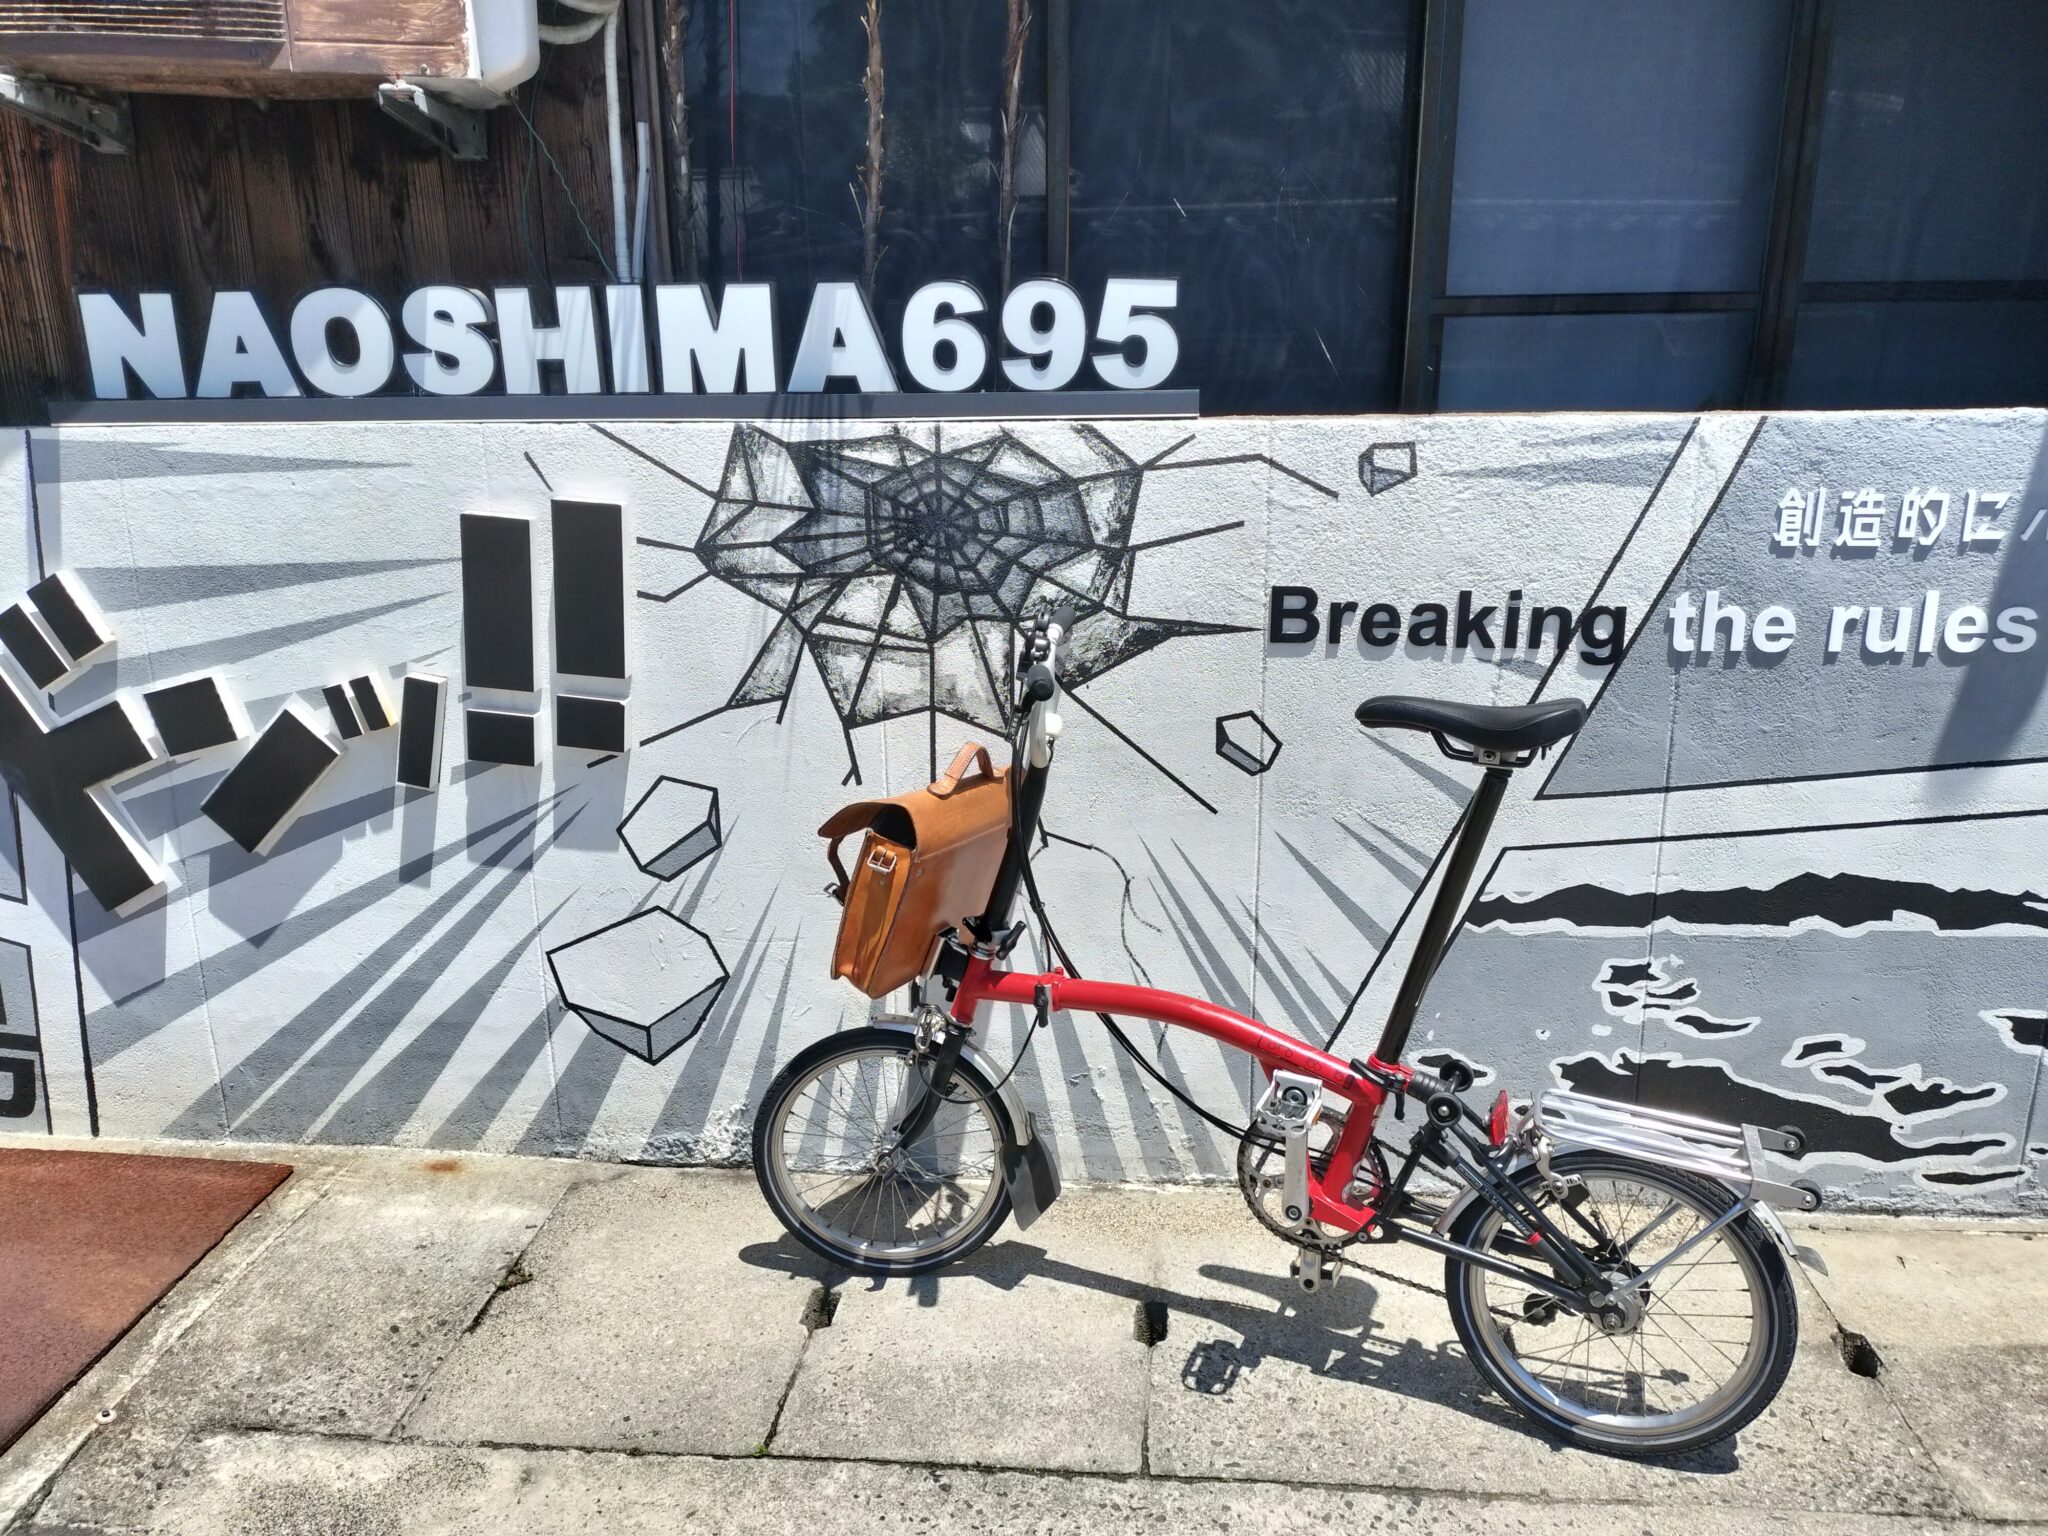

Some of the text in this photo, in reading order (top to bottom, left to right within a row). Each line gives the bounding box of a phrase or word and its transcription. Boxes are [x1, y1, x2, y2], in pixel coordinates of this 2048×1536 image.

[77, 277, 1181, 399] NAOSHIMA695
[1269, 585, 2039, 665] Breaking the rules
